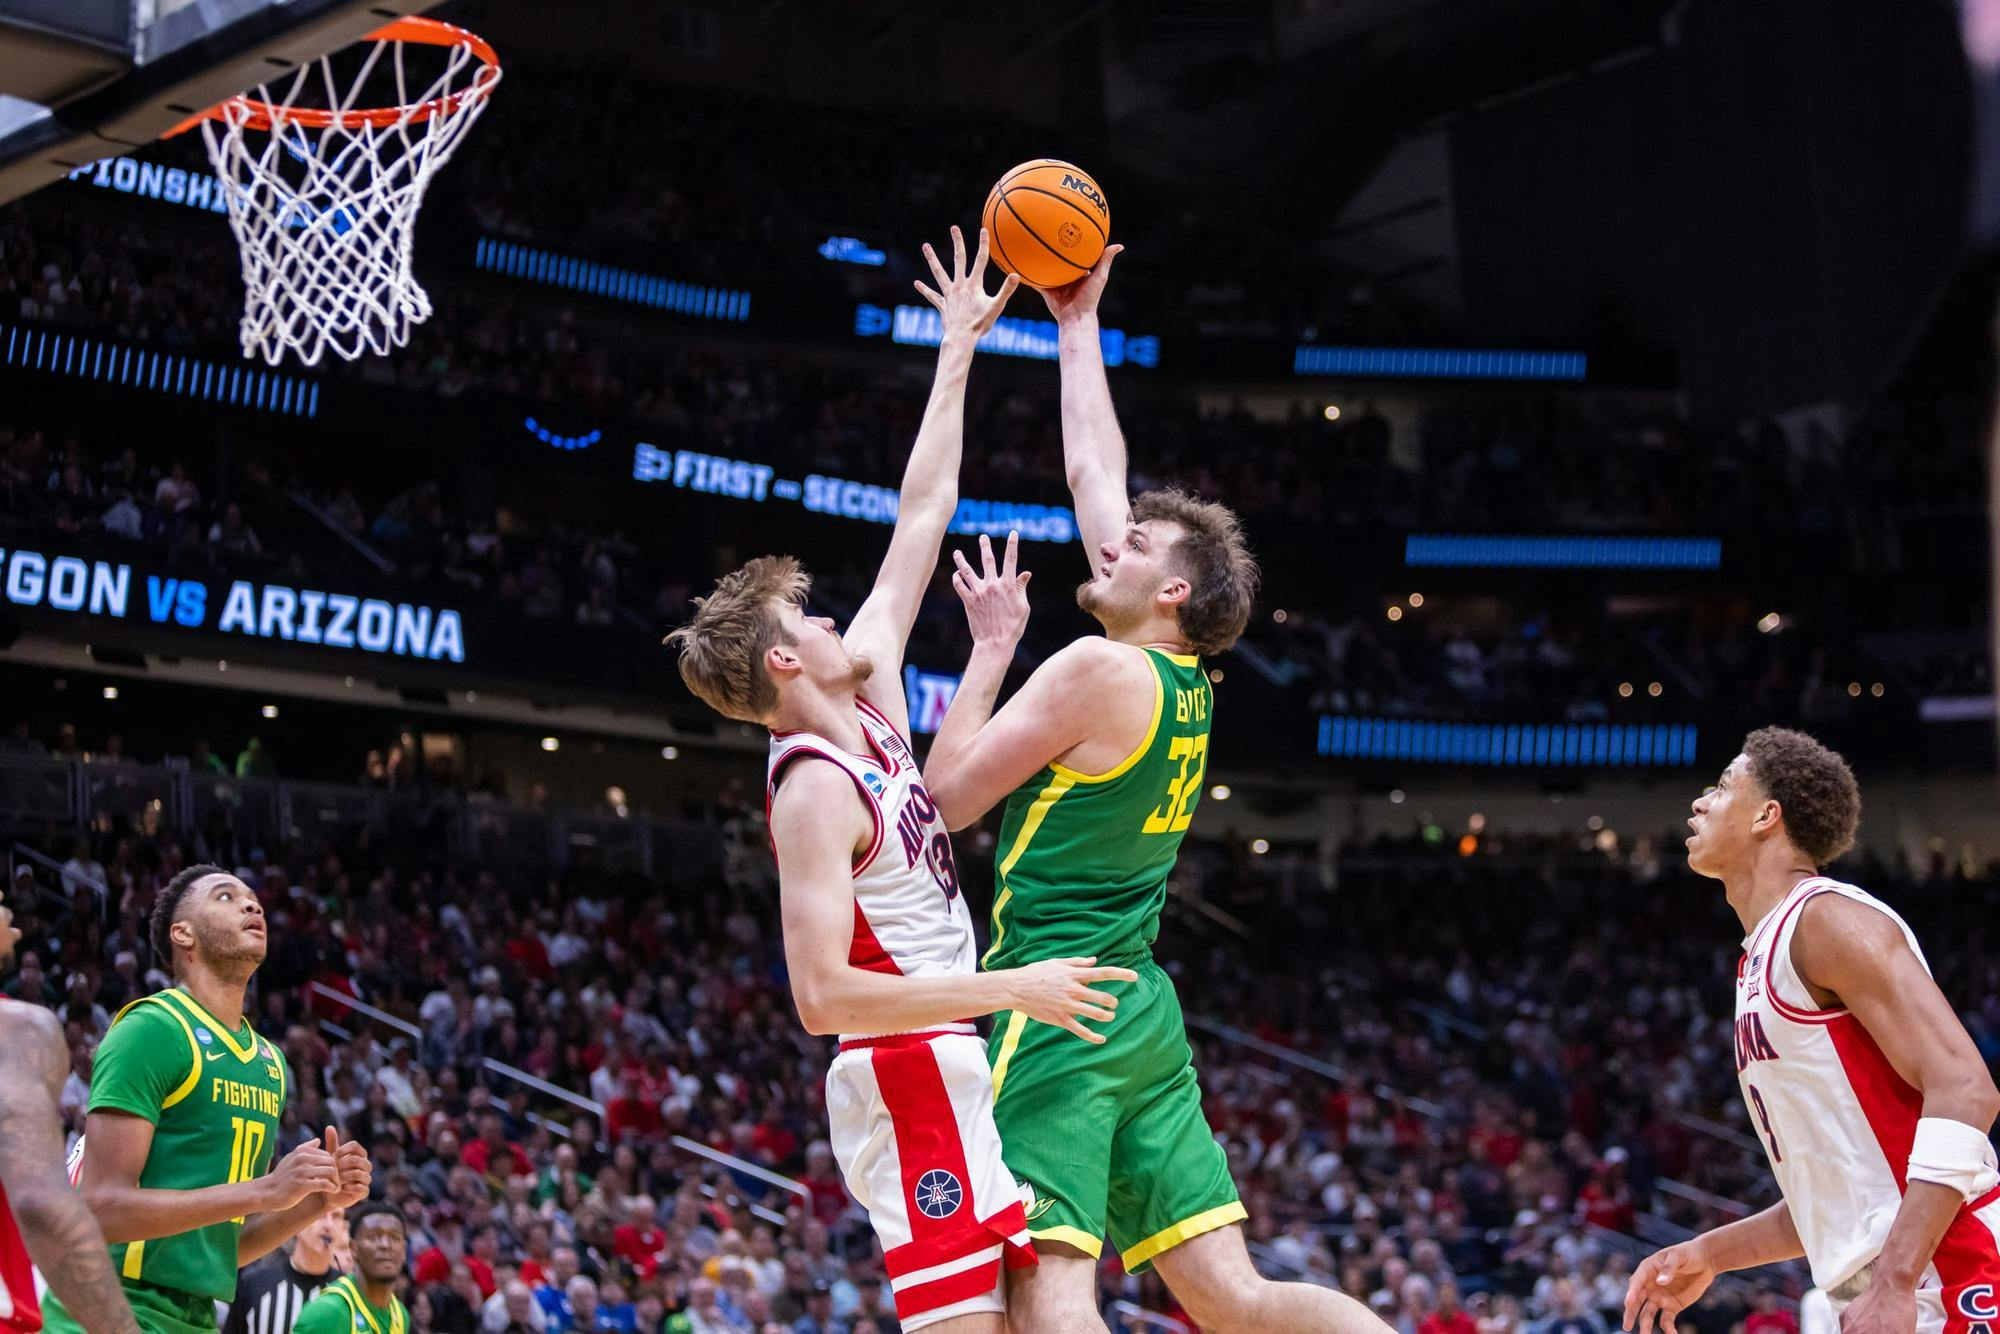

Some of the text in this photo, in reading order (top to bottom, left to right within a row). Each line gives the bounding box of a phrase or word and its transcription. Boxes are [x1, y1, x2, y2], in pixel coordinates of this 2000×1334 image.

[1058, 173, 1107, 218] NCAA
[673, 450, 773, 502] FIRST
[803, 474, 901, 526] SECON
[0, 547, 466, 663] GON VS ARIZONA
[1141, 733, 1209, 834] 32
[212, 1077, 279, 1119] FIGHTING
[227, 1116, 266, 1224] 10
